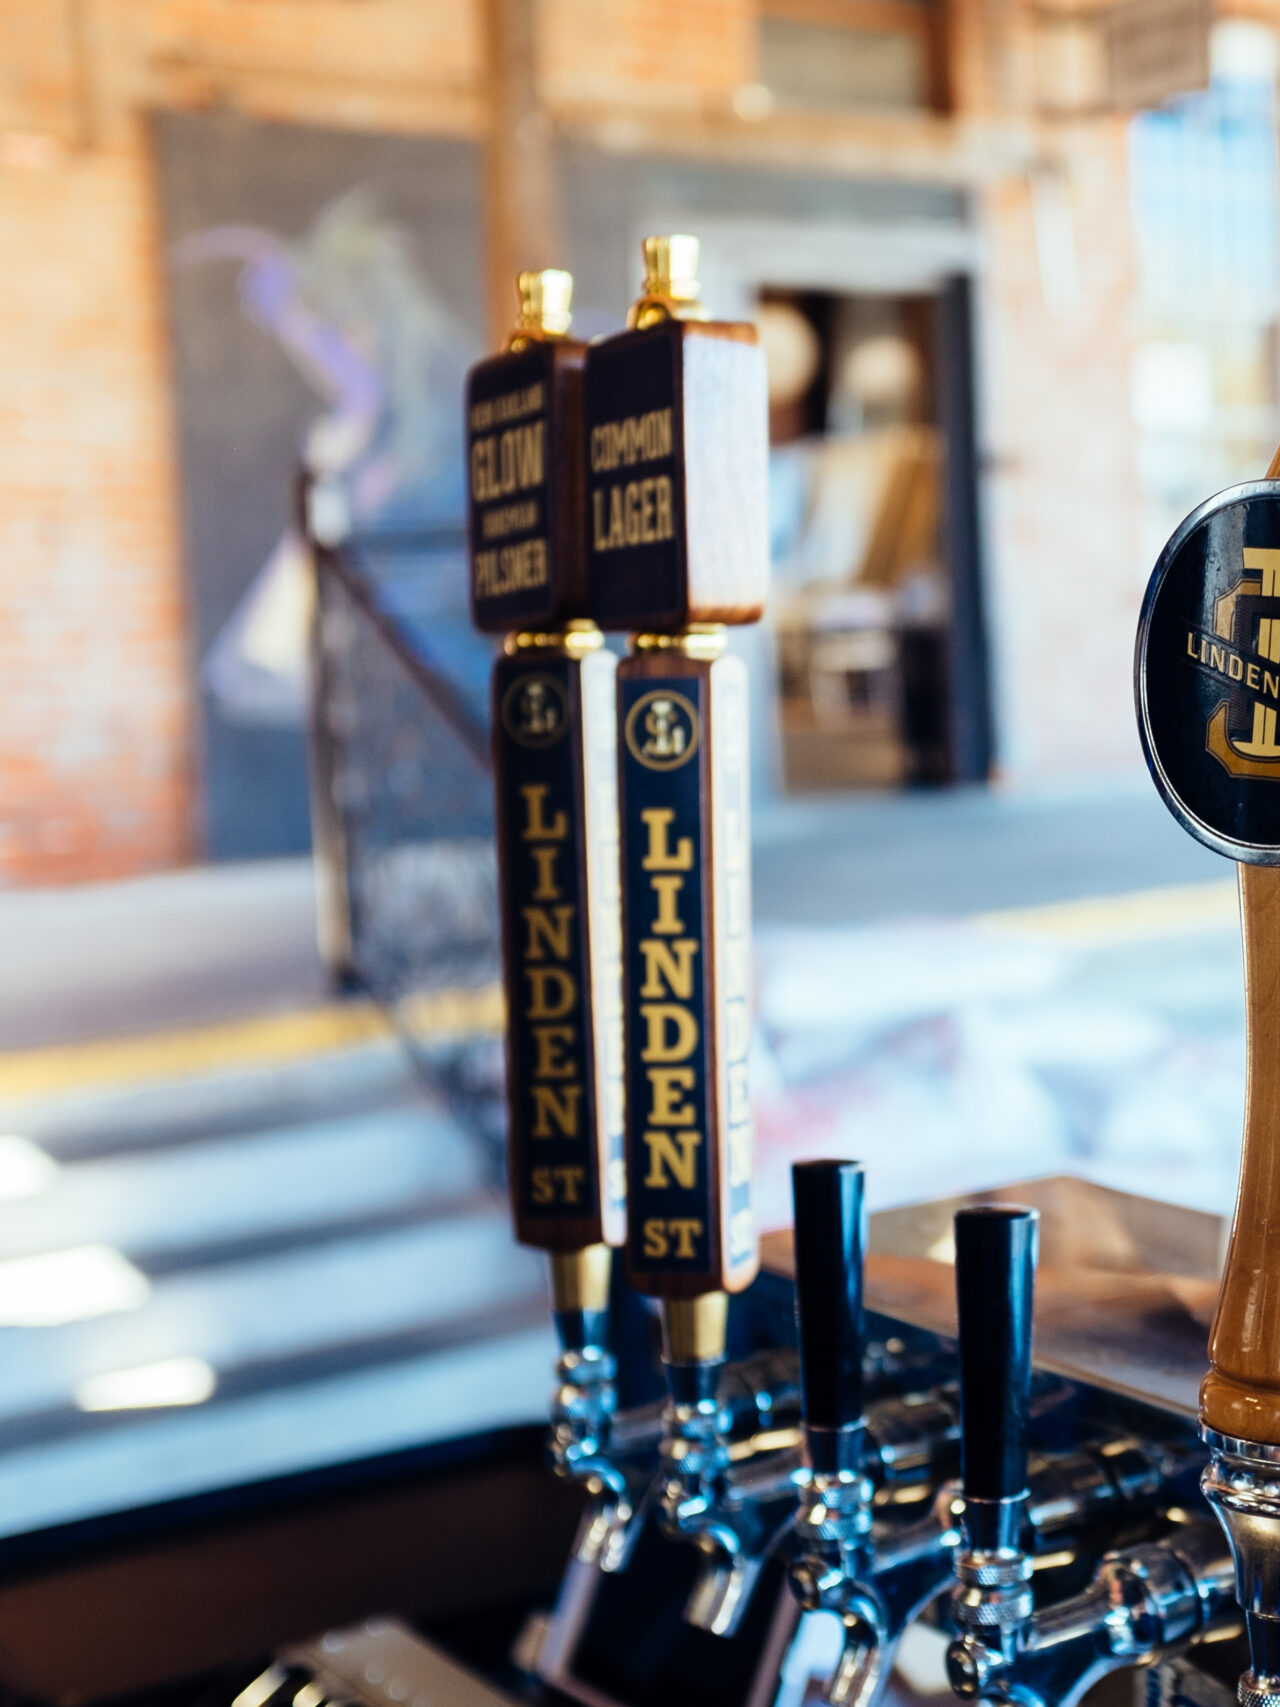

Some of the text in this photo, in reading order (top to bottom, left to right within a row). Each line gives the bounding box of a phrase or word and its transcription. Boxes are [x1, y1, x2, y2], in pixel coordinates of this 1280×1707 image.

[471, 420, 545, 503] GLOW
[590, 406, 673, 474] COMMON
[592, 474, 674, 553] LAGER
[1186, 631, 1280, 700] LINDEN
[521, 783, 583, 1139] LINDEN
[639, 807, 702, 1191] LINDEN
[531, 1165, 585, 1205] ST
[643, 1218, 702, 1260] ST
